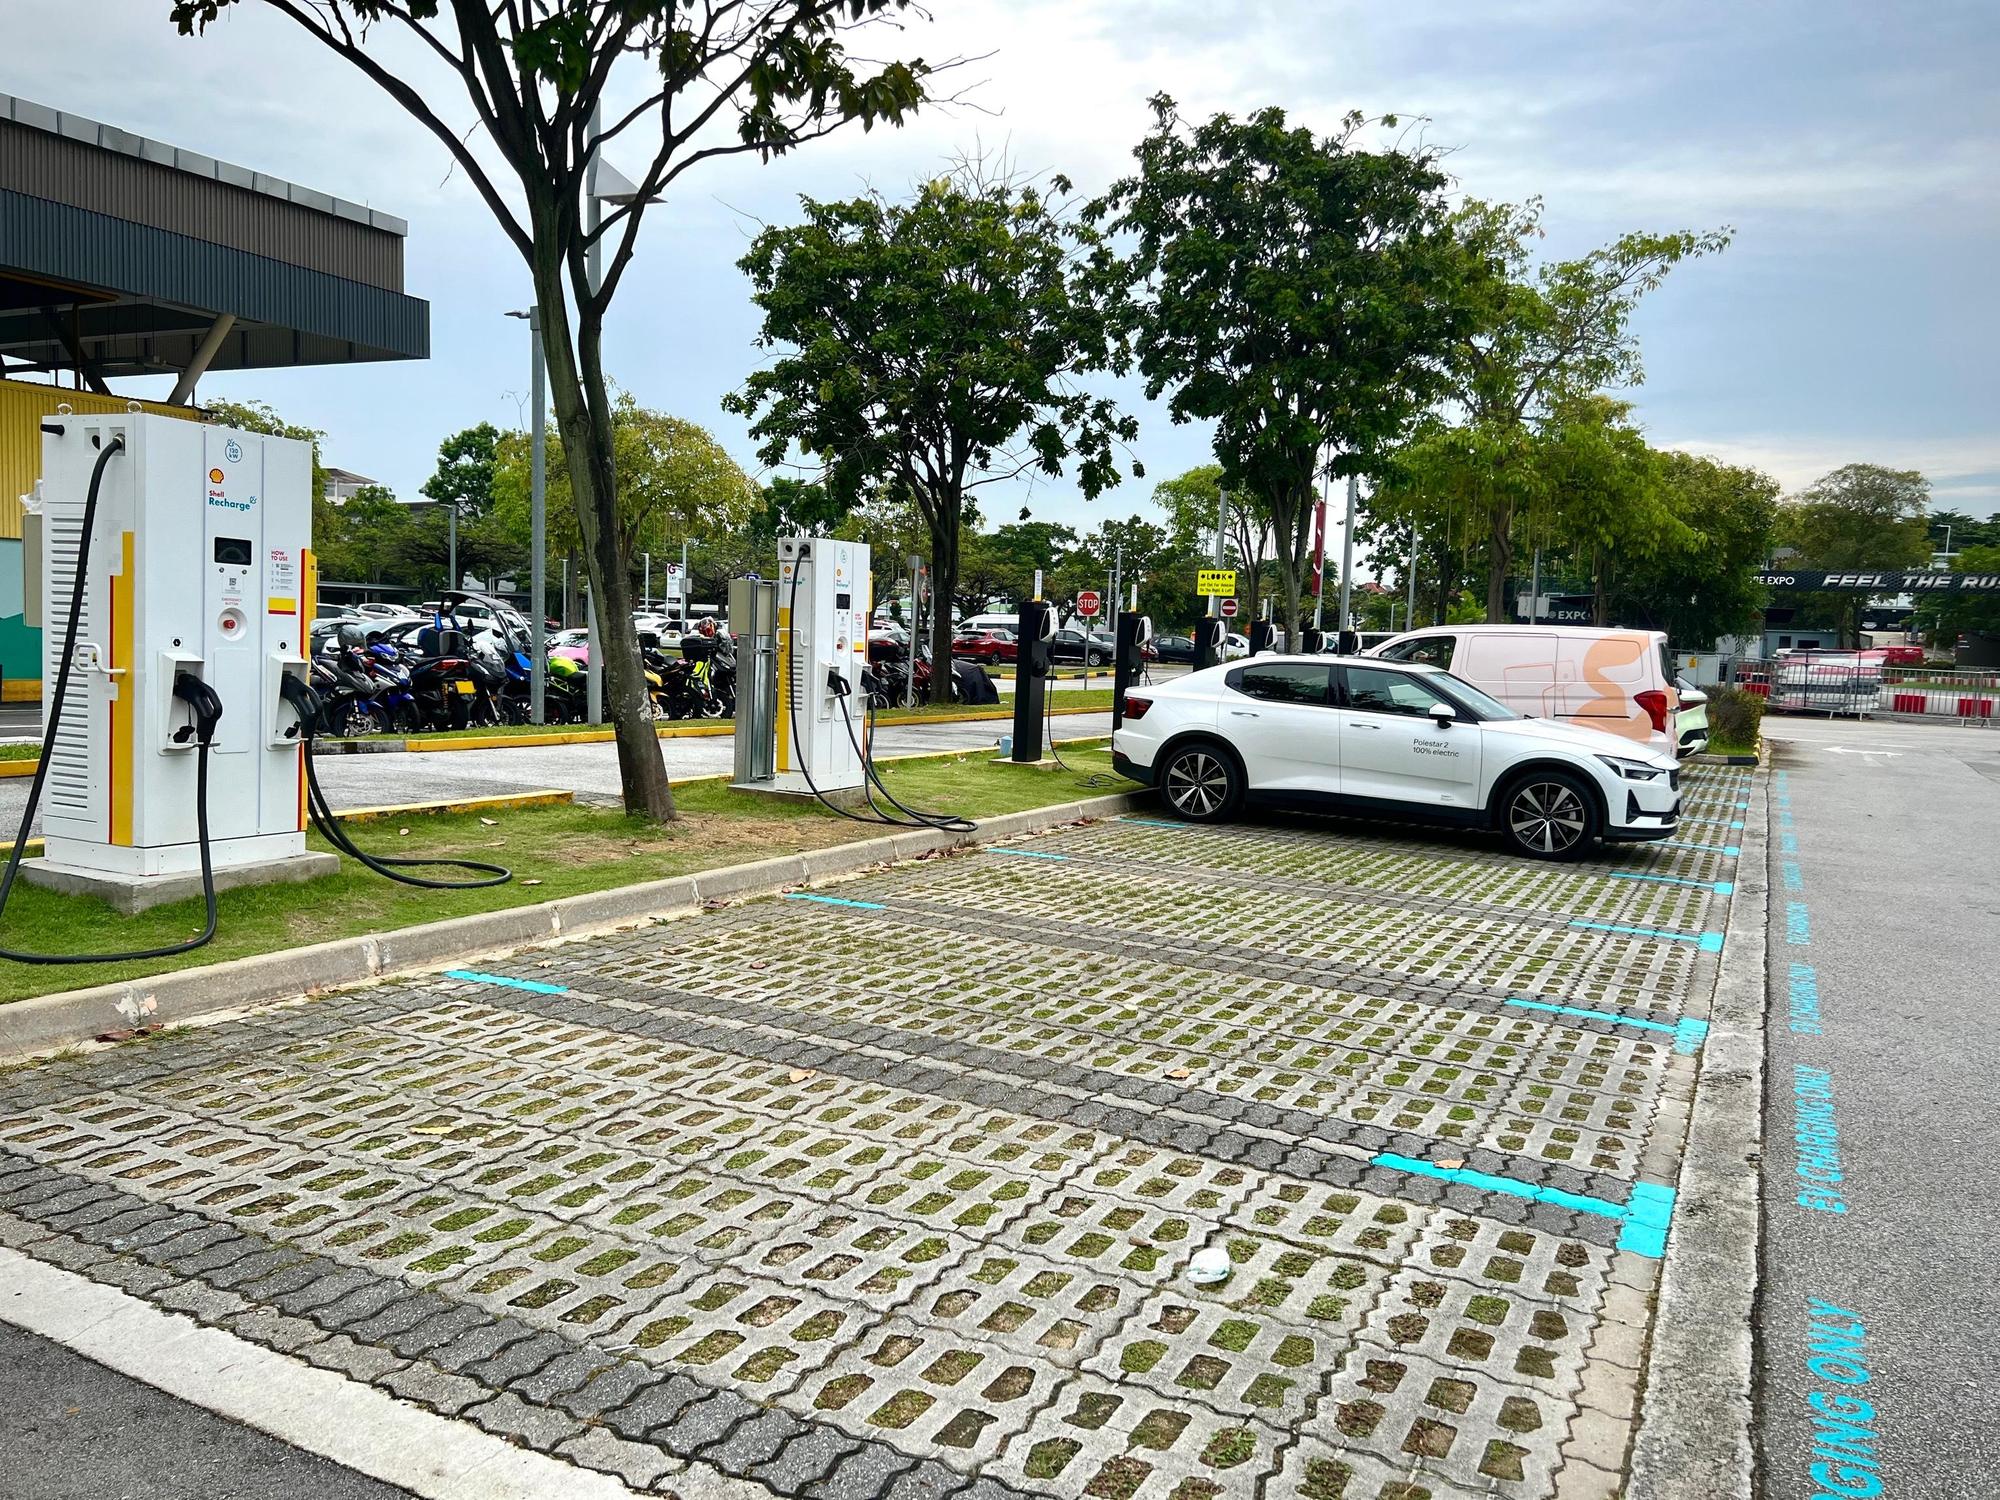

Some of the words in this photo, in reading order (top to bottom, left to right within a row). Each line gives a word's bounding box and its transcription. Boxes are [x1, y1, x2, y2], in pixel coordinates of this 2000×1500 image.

[208, 490, 225, 498] Shell
[208, 497, 251, 511] Recharge
[1767, 576, 1795, 585] EXPO
[1821, 575, 1887, 587] FEEL
[1902, 576, 1953, 588] THE
[1960, 576, 2000, 589] RU
[1078, 598, 1098, 609] STOP
[1413, 738, 1443, 748] Polestar
[1413, 746, 1431, 755] 100%
[1432, 749, 1460, 758] electric
[1792, 1062, 1834, 1099] ONLY
[1794, 1099, 1845, 1182] CHARGING
[1797, 1181, 1847, 1214] EV
[1807, 1296, 1873, 1385] ONLY
[1809, 1391, 1885, 1500] GING
